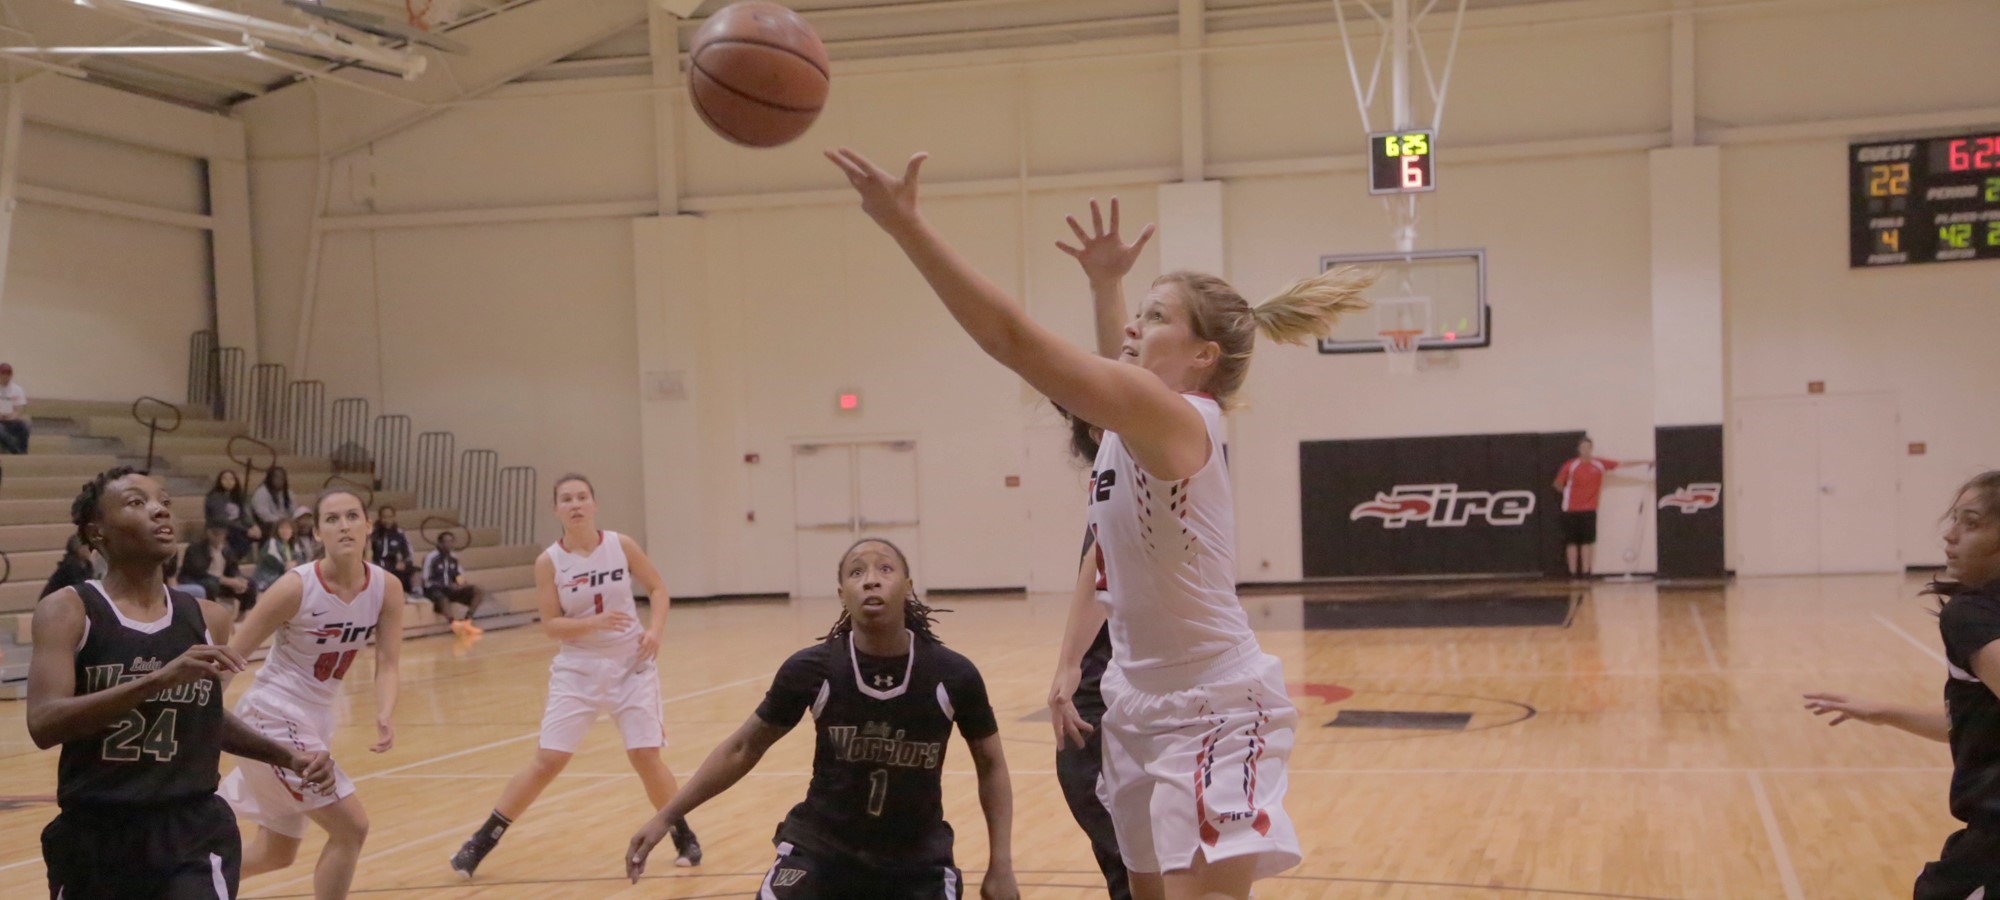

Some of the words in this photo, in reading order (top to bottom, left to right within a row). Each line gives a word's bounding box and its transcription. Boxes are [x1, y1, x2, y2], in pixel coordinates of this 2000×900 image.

[1402, 154, 1422, 188] 6
[1870, 162, 1910, 197] 22
[1881, 228, 1900, 252] 4
[1939, 223, 1973, 248] 42
[1350, 483, 1536, 528] Fire
[562, 568, 624, 593] Fire
[102, 708, 178, 762] 24
[867, 768, 888, 816] 1
[1212, 811, 1254, 824] Fire
[772, 868, 808, 887] W
